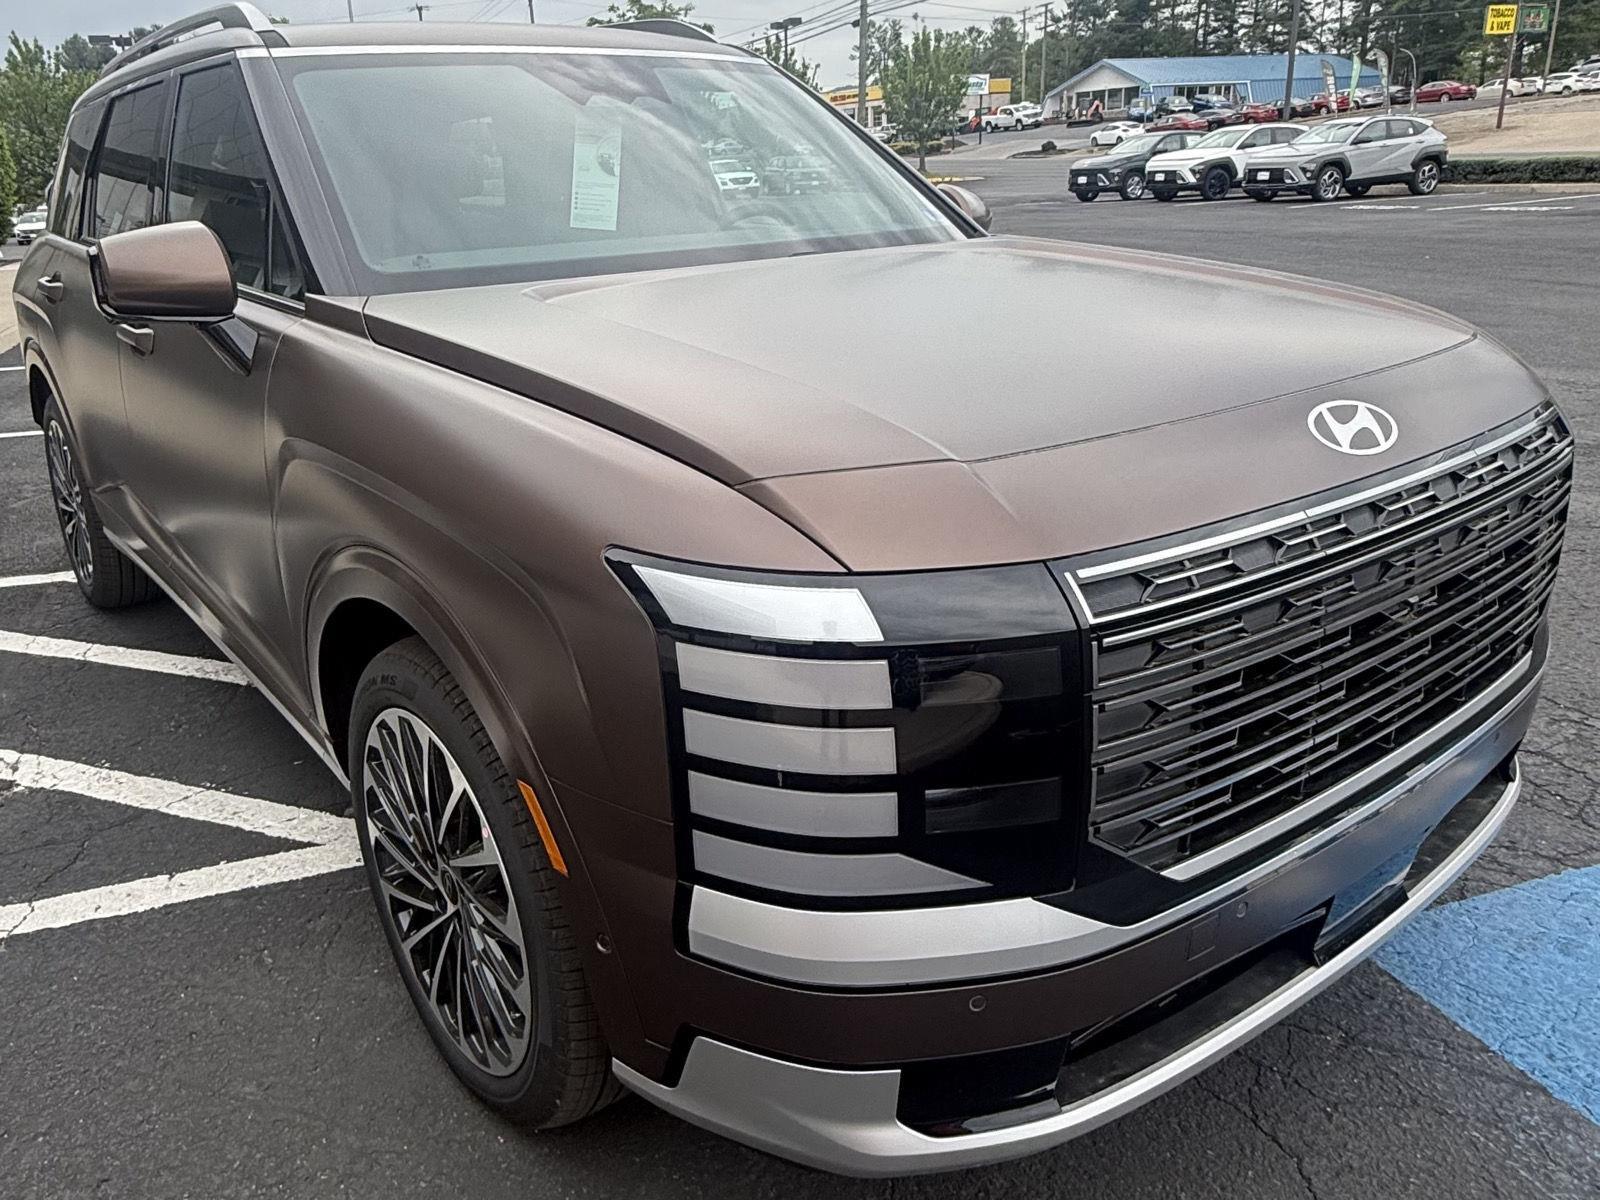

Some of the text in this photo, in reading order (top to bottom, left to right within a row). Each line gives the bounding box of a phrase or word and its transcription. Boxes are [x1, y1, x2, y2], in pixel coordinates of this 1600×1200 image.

[1490, 8, 1515, 18] TOBACCO
[1490, 20, 1495, 31] &
[1496, 20, 1512, 31] VAPE
